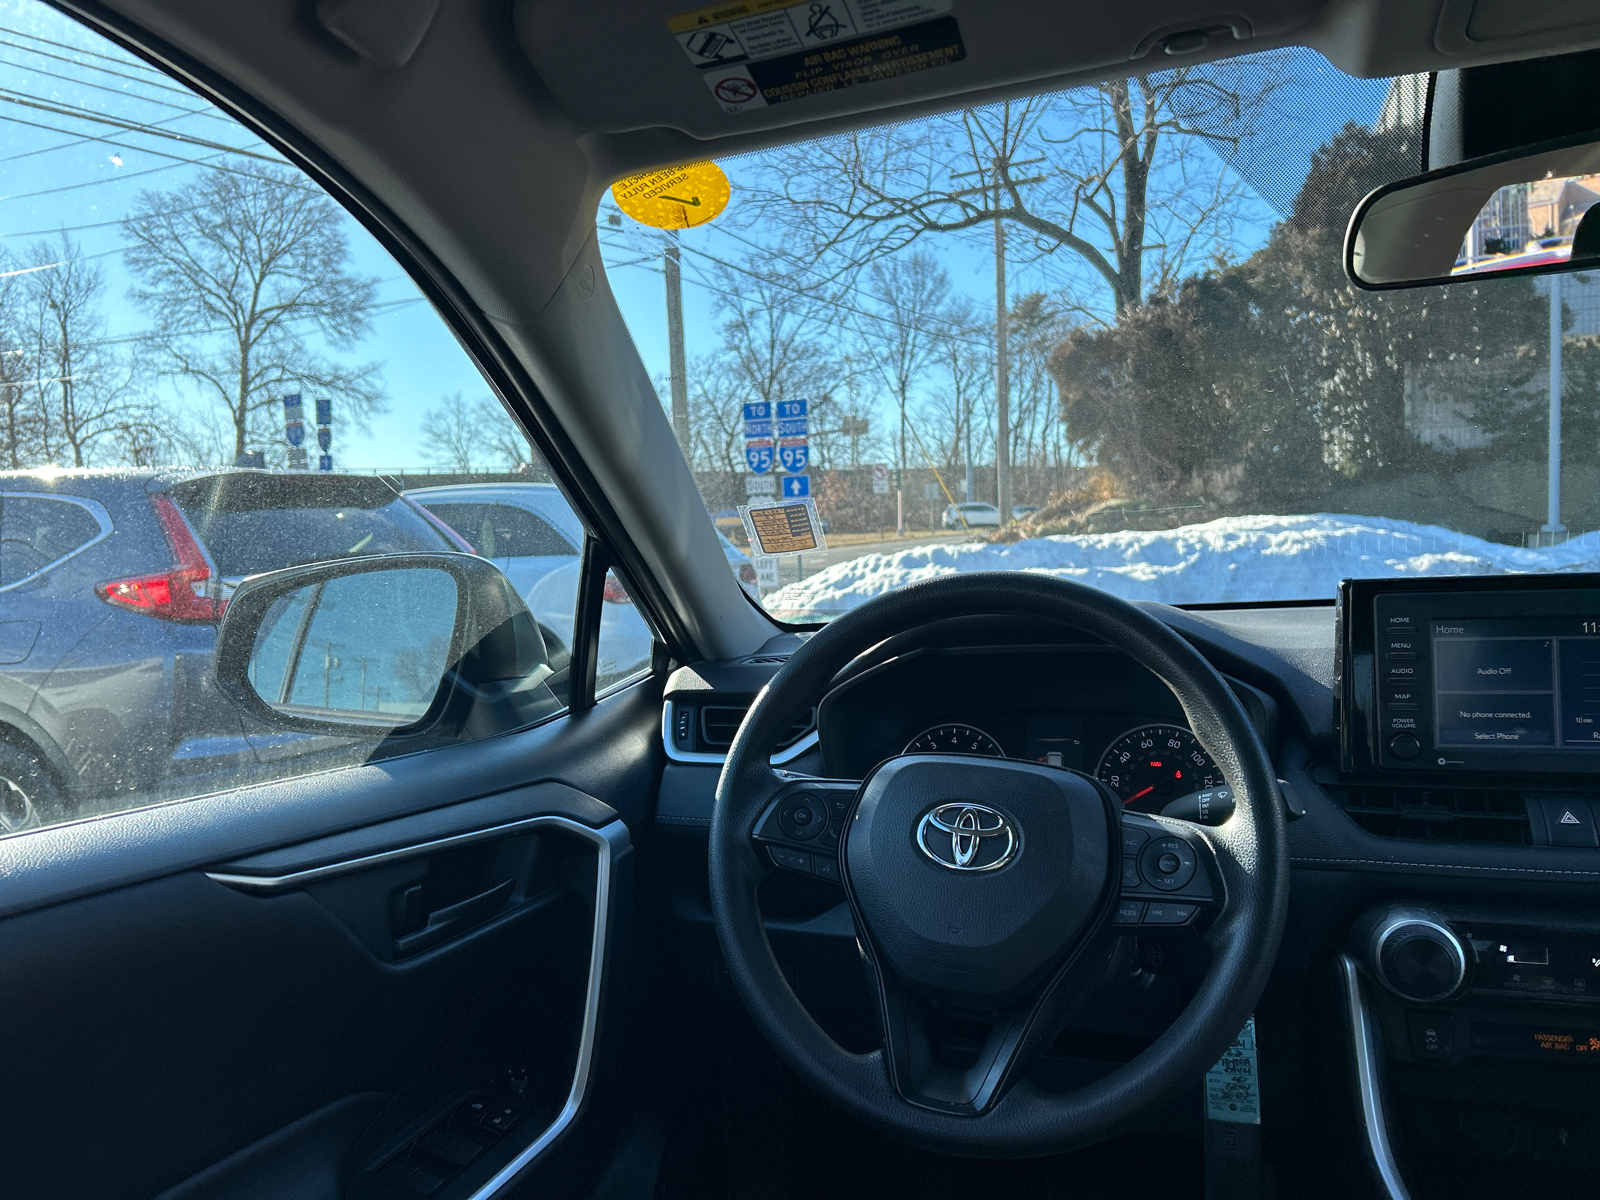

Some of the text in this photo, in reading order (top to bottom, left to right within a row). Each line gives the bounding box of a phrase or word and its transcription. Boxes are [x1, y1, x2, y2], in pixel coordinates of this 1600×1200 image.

[804, 35, 902, 67] AIR BAG WARNING
[795, 43, 920, 79] FLIP VISOR OVER
[763, 80, 810, 98] COUSSIN
[872, 43, 959, 73] AVERTISSEMENT
[750, 405, 766, 417] TO
[784, 403, 801, 415] TO
[745, 422, 772, 435] NORTH
[779, 421, 808, 434] SOUTH
[749, 451, 770, 469] 95
[783, 449, 806, 468] 95
[746, 479, 774, 491] SOUTH
[1436, 625, 1465, 634] Home
[1477, 667, 1512, 675] Audio Off
[1471, 711, 1493, 720] phone
[1494, 711, 1532, 719] connected.
[950, 736, 958, 744] 4
[1474, 732, 1495, 740] Select
[930, 741, 938, 750] 3
[970, 741, 979, 750] 5
[1140, 738, 1154, 749] 60
[1167, 738, 1181, 750] 80
[1119, 751, 1131, 764] 40
[1190, 750, 1206, 767] 100
[1110, 775, 1120, 788] 20
[1204, 774, 1214, 790] 120
[1534, 1033, 1575, 1043] PASSENGER
[1540, 1041, 1589, 1052] AIR BAG OFF
